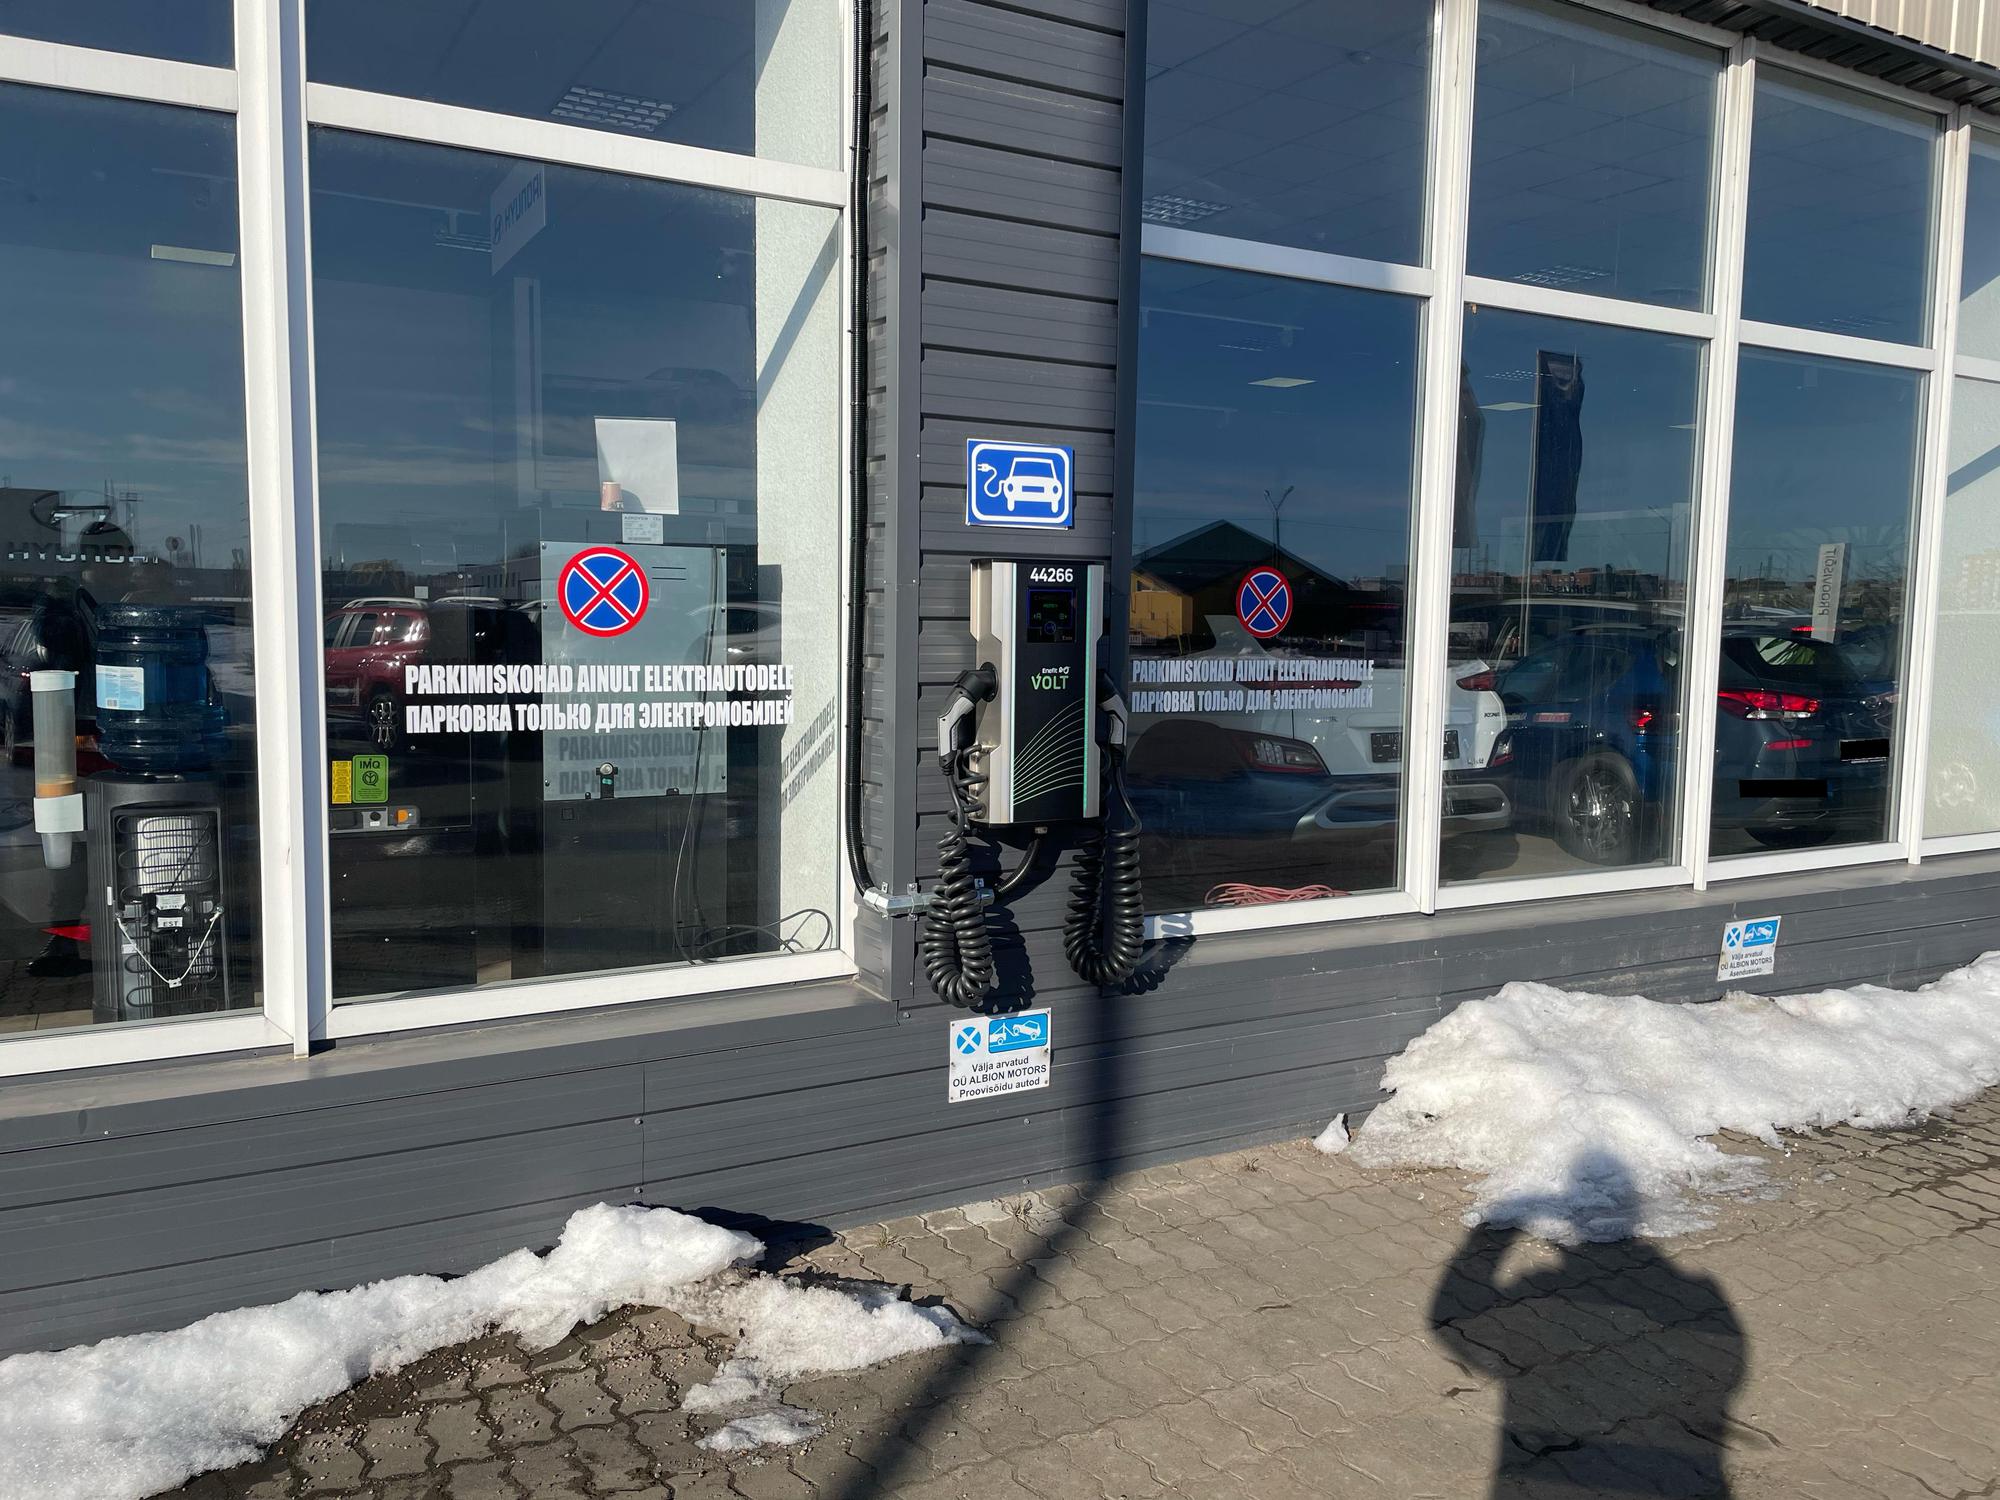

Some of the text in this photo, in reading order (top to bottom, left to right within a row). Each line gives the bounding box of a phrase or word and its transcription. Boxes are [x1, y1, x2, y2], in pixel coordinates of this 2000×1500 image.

[1030, 567, 1074, 583] 44266
[405, 664, 794, 695] PARKIMISKOHAD AINULT ELEKTRIAUTODELE
[1031, 673, 1069, 690] VOLT
[1132, 660, 1374, 682] PARKIMISKOHAD AINULT ELEKTRIAUTODELE
[1132, 684, 1373, 713] ПАРКОВКА ТОЛЬКО ДЛЯ ЭЛЕКТРОМОБИЛЕЙ
[406, 695, 794, 734] ПАРКОВКА ТОЛЬКО ДЛЯ ЭЛЕКТРОМОБИЛЕЙ
[972, 1056, 1029, 1073] Välja arvatud
[953, 1064, 1047, 1088] OÜ ALBION MOTORS
[959, 1077, 1040, 1098] Proovisõidu autod
